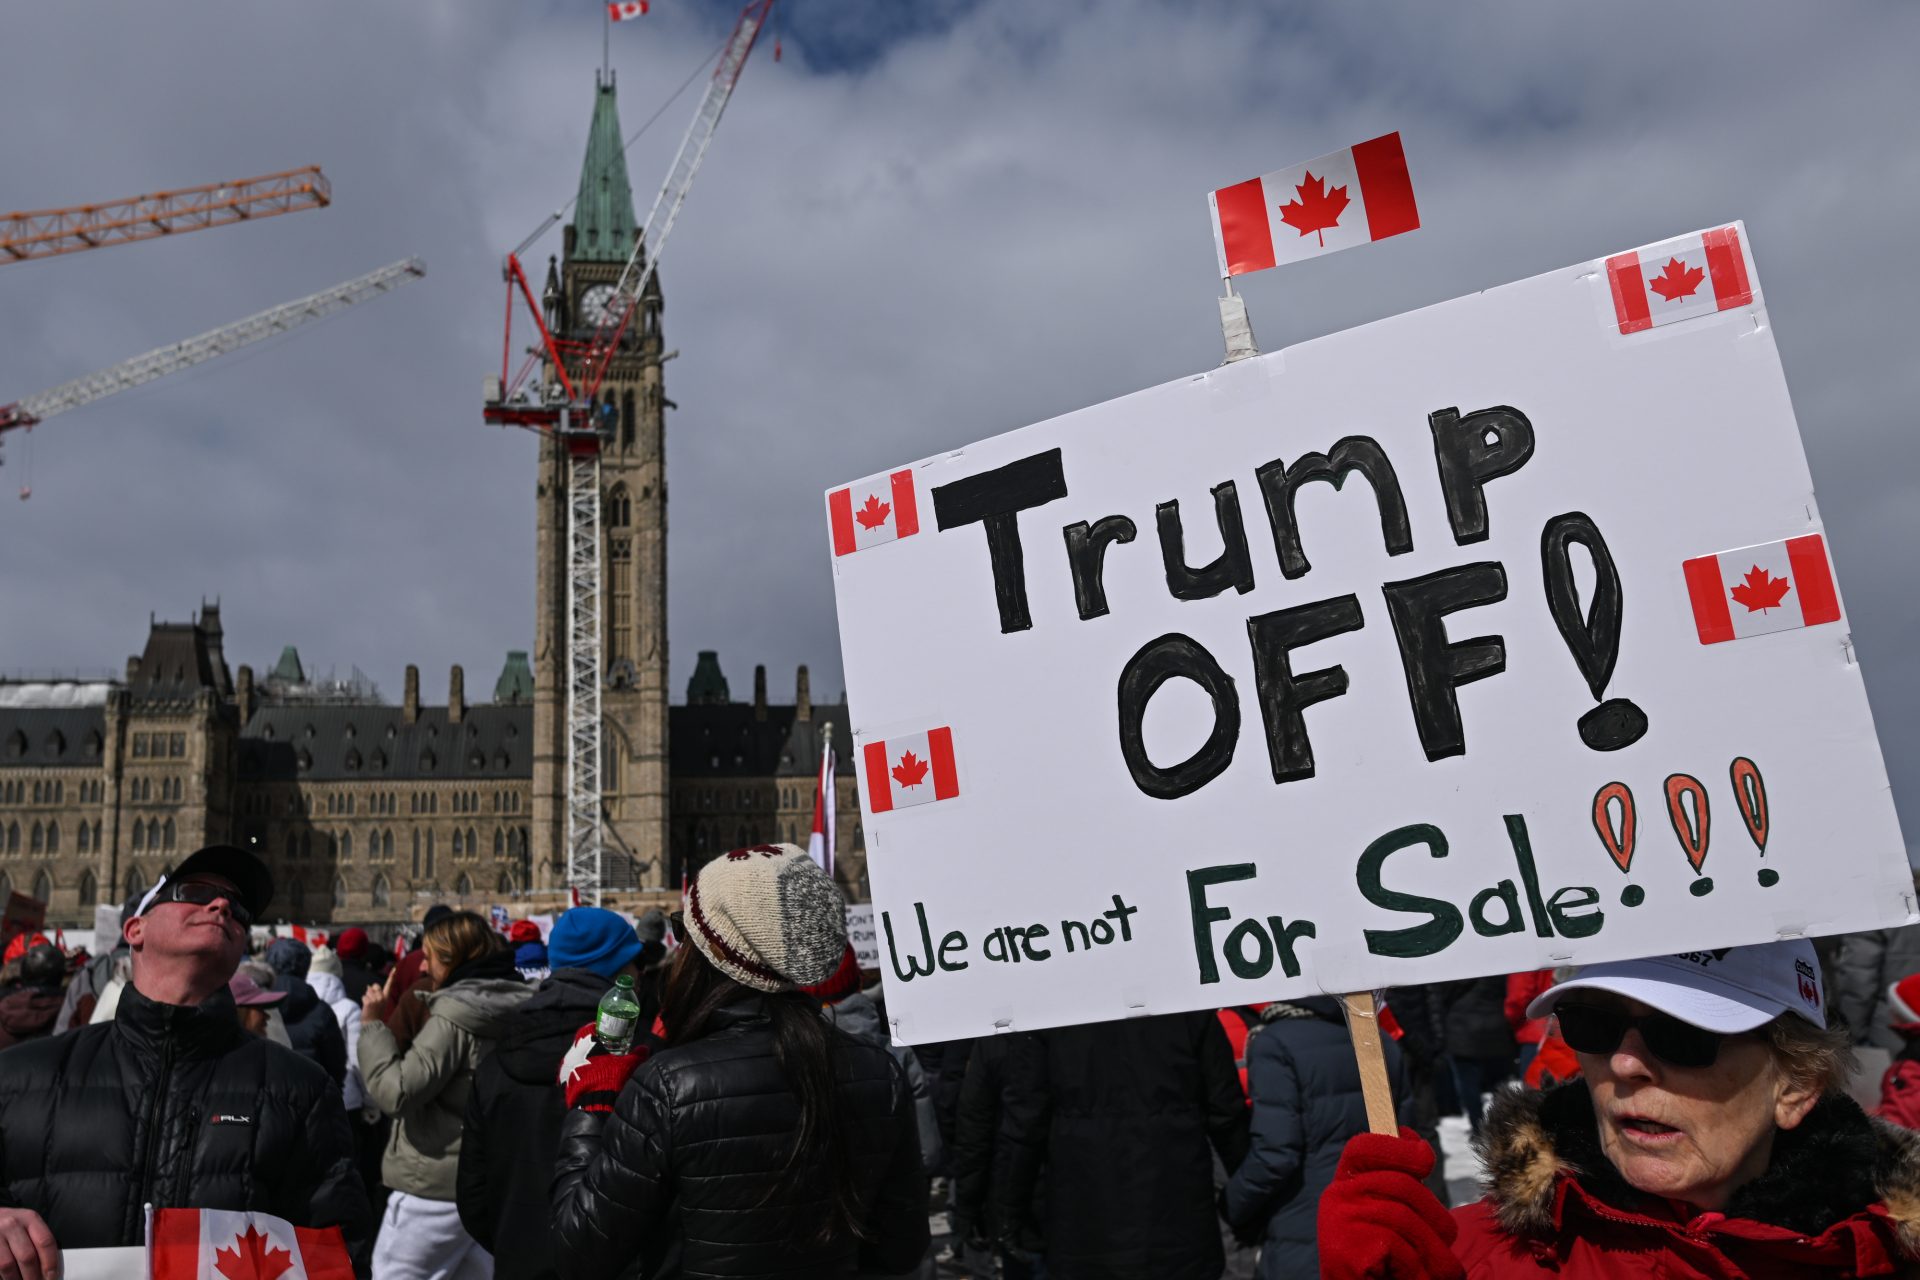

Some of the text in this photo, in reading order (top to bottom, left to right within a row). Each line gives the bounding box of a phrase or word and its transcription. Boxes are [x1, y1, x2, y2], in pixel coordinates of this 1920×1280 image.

[1117, 510, 1649, 801] OFF!
[881, 901, 969, 983] We
[983, 923, 1052, 963] are
[1061, 894, 1138, 953] not
[1185, 862, 1317, 985] For
